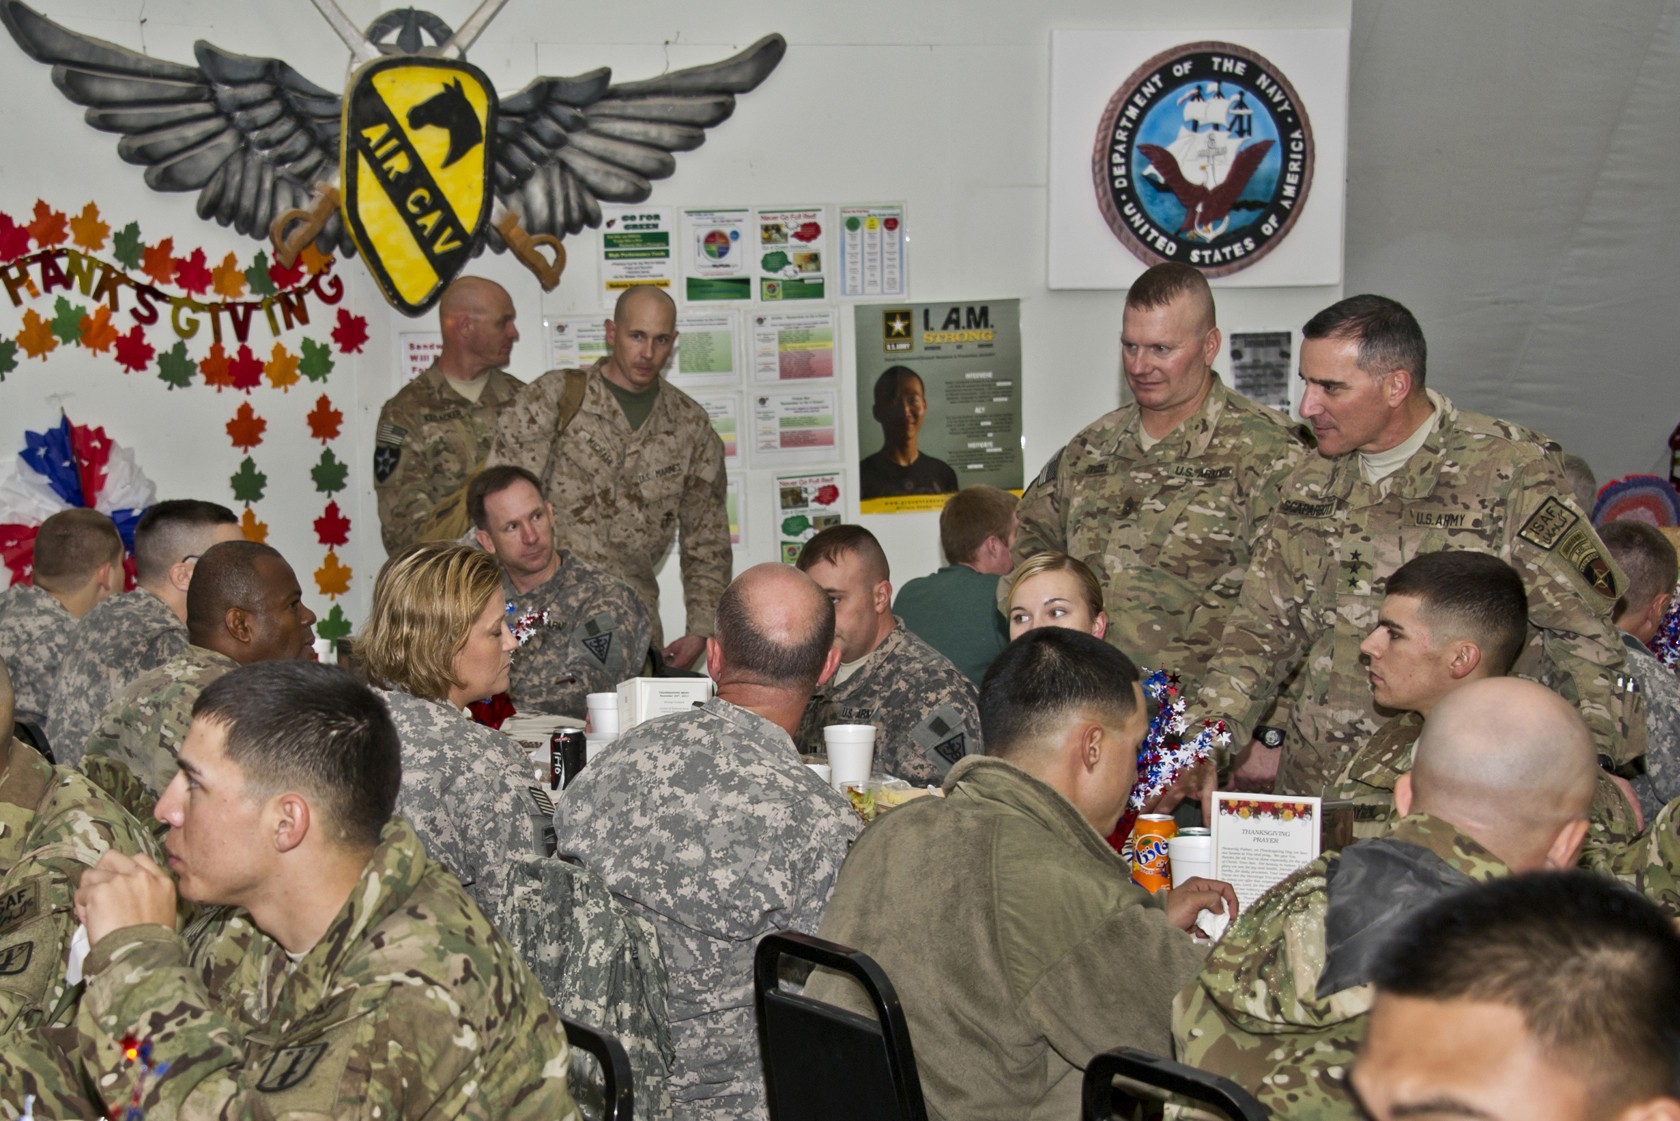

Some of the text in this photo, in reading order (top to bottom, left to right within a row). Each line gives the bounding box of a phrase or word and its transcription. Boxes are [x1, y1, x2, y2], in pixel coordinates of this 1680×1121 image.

[1112, 57, 1292, 189] DEPARTMENT OF THE NAVY
[360, 123, 462, 255] AIR CAV
[1123, 129, 1304, 264] UNITED STATES OF AMERICA
[639, 213, 661, 222] FOR
[623, 223, 659, 231] GREEN
[923, 330, 993, 344] STRONG
[1175, 465, 1194, 478] U.S.
[1416, 512, 1466, 527] U.S. ARMY
[1529, 507, 1557, 536] ISAF
[842, 707, 852, 719] U.S.
[1241, 828, 1291, 837] THANKSGIVING
